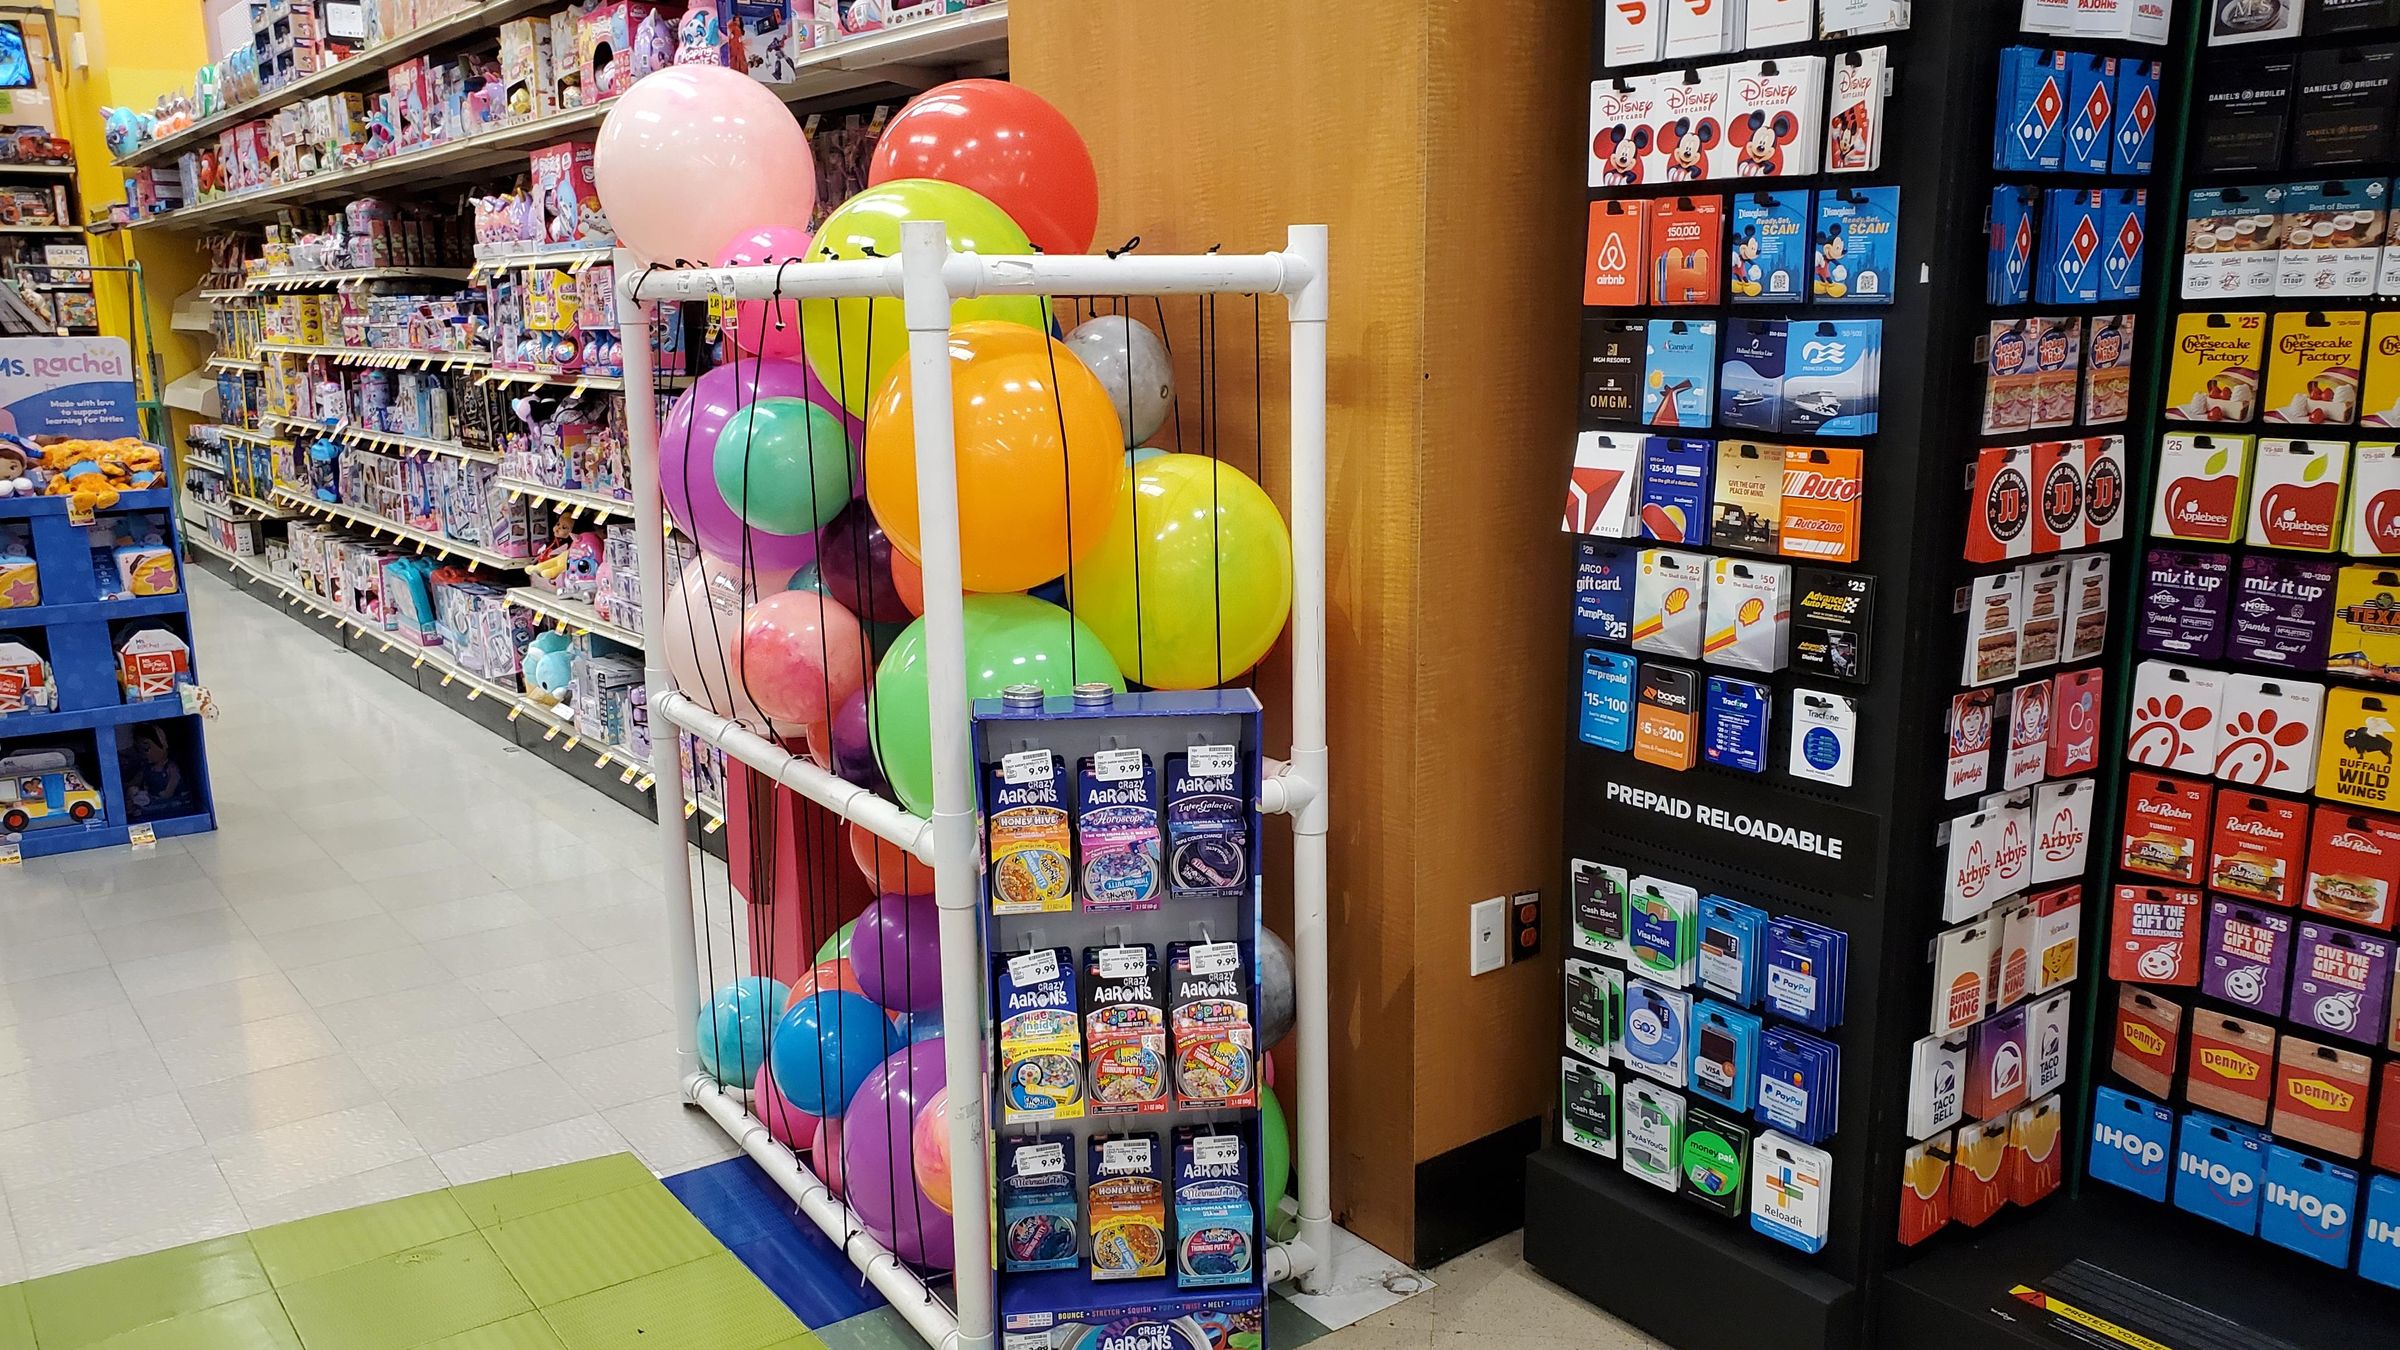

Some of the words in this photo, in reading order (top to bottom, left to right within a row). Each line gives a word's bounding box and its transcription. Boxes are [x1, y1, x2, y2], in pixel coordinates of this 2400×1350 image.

[1738, 79, 1798, 105] Disney
[2303, 83, 2338, 93] DANIEL'S
[2354, 79, 2388, 88] BROILER
[1664, 87, 1718, 111] Disney
[1747, 98, 1766, 107] GIFT
[1767, 97, 1787, 107] CARD
[2208, 91, 2240, 101] DANIEL'S
[2254, 89, 2286, 98] BROILER
[1673, 106, 1690, 115] GIFT
[2211, 208, 2227, 216] Best
[2237, 207, 2260, 215] Brews
[1666, 225, 1700, 237] 150,000
[1762, 223, 1799, 235] SCAN!
[1596, 274, 1625, 285] airbnb
[2238, 316, 2260, 329] $25
[2182, 334, 2251, 354] Cheesecake
[33, 353, 123, 377] Rachel
[2198, 352, 2249, 366] Factory
[77, 399, 95, 407] with
[96, 399, 115, 407] love
[1590, 395, 1632, 409] OMGM.
[73, 407, 107, 417] support
[46, 417, 82, 426] learning
[84, 416, 98, 424] for
[99, 415, 124, 423] littles
[2167, 440, 2182, 451] $25
[1649, 464, 1674, 473] $25-500
[1728, 480, 1740, 488] GIVE
[1748, 481, 1759, 489] GIFT
[1729, 487, 1743, 496] PEACE
[1743, 488, 1749, 496] OF
[2177, 509, 2228, 524] Applebee's
[1582, 545, 1594, 555] $25
[1579, 563, 1601, 574] ARCO
[1686, 565, 1700, 575] $25
[1576, 576, 1594, 592] gift
[1760, 575, 1775, 584] $50
[1848, 580, 1866, 592] $25
[2151, 568, 2182, 583] mix
[2184, 569, 2197, 585] it
[2198, 575, 2221, 592] up
[1805, 591, 1844, 605] Advance
[1800, 599, 1820, 608] Auto
[1820, 600, 1842, 612] Parts
[1577, 606, 1615, 622] PumpPass
[1604, 621, 1627, 638] $25
[1597, 670, 1627, 684] prepaid
[1584, 691, 1628, 713] $15-$100
[1657, 689, 1687, 705] boost
[1722, 697, 1748, 709] Tracfone
[1807, 709, 1840, 722] Tracfone
[1658, 726, 1684, 743] $200
[2069, 747, 2090, 760] SONIC
[1028, 765, 1050, 775] 9.99
[1119, 764, 1141, 773] 9.99
[1212, 760, 1233, 768] 9.99
[2339, 757, 2392, 774] BUFFALO
[2338, 767, 2390, 789] WILD
[2337, 782, 2387, 801] WINGS
[2137, 799, 2157, 814] Red
[2158, 802, 2193, 820] Robin
[1000, 816, 1033, 827] HONEY
[1034, 815, 1058, 825] HIVE
[1092, 813, 1145, 825] Horoscope
[1607, 781, 1692, 820] PREPAID
[1696, 805, 1843, 860] RELOADABLE
[2039, 827, 2084, 851] Arby's
[1994, 840, 2028, 869] Arby's
[2176, 893, 2198, 905] $15
[1581, 904, 1599, 916] Cash
[1600, 908, 1618, 919] Back
[2133, 903, 2161, 916] GIVE
[2162, 904, 2186, 918] THE
[2132, 915, 2164, 929] GIFT
[2166, 917, 2185, 931] OF
[2265, 917, 2288, 932] $25
[1636, 928, 1651, 941] Visa
[1651, 934, 1670, 948] Debit
[2131, 928, 2184, 938] DELICIOUSNESS
[1123, 960, 1144, 970] 9.99
[1216, 957, 1237, 968] 9.99
[1035, 964, 1056, 976] 9.99
[1782, 978, 1811, 995] PayPal
[1949, 987, 1980, 1006] BURGER
[1949, 999, 1979, 1022] KING
[2125, 1024, 2163, 1054] Denny's
[1102, 1065, 1124, 1074] THINKING
[1125, 1066, 1143, 1074] PUTTY
[2040, 1056, 2059, 1075] TACO
[2204, 1051, 2256, 1077] Denny's
[2040, 1070, 2059, 1086] BELL
[1775, 1089, 1803, 1107] PayPal
[1933, 1093, 1955, 1112] TACO
[1570, 1102, 1588, 1114] Cash
[1589, 1108, 1606, 1120] Back
[1933, 1108, 1954, 1125] BELL
[2095, 1123, 2164, 1167] IHOP
[1127, 1154, 1148, 1164] 9.99
[1217, 1149, 1238, 1159] 9.99
[1690, 1141, 1735, 1165] moneypak
[1041, 1158, 1062, 1168] 9.99
[1099, 1186, 1129, 1195] HONEY
[1131, 1184, 1152, 1194] HIVE
[1183, 1188, 1221, 1199] Mermaid
[2266, 1182, 2347, 1230] IHOP
[1764, 1204, 1803, 1228] Reloadit
[1058, 1311, 1085, 1321] BOUNCE
[1091, 1308, 1121, 1319] STRETCH
[1127, 1306, 1151, 1315] SQUISH
[1181, 1302, 1201, 1311] TWIST
[1208, 1300, 1225, 1309] MELT
[1231, 1298, 1253, 1307] FIDGET
[2062, 1306, 2115, 1332] PROTECT
